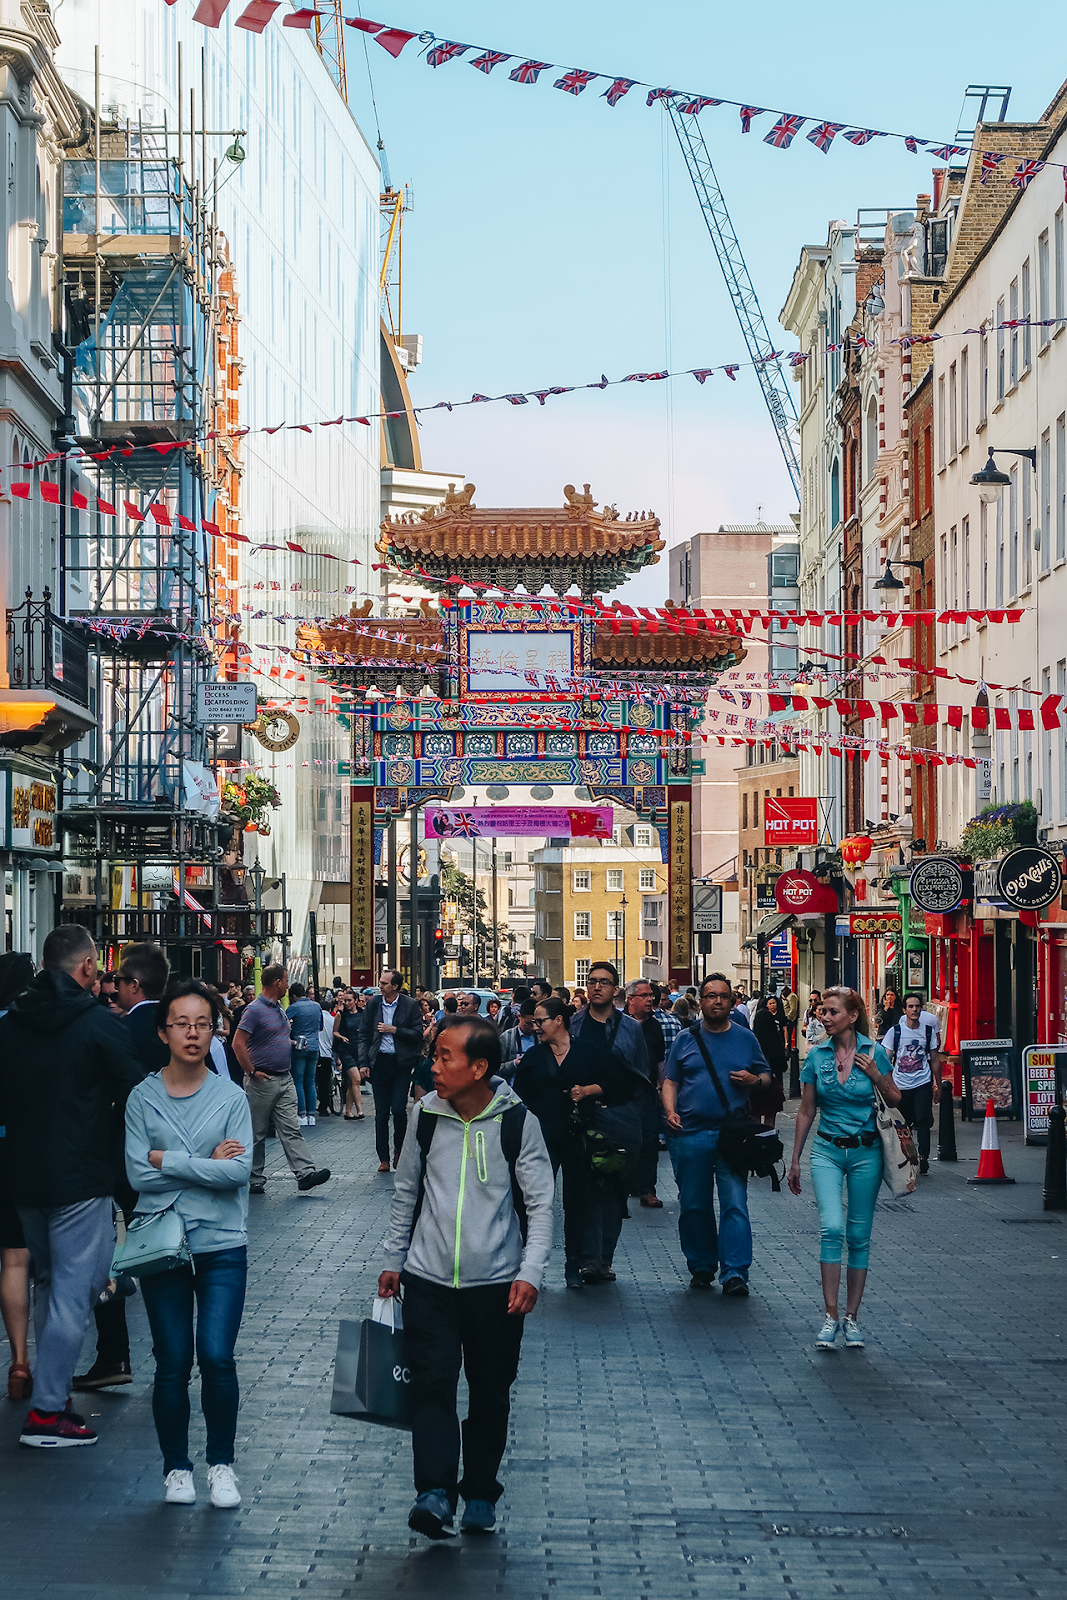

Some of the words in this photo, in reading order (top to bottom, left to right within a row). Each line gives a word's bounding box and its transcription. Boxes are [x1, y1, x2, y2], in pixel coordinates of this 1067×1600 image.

[770, 391, 786, 425] WOLFF
[472, 648, 569, 671] 英倫呈祥
[765, 819, 790, 831] HOT
[792, 819, 816, 831] POT
[1005, 858, 1053, 897] O'Neill's
[782, 888, 797, 896] HOT
[798, 888, 813, 896] POT
[1015, 895, 1027, 904] EAT
[1031, 893, 1050, 905] DRINK
[1049, 870, 1057, 891] ENJOY
[1032, 1054, 1051, 1066] SUN
[1029, 1068, 1049, 1079] BEER
[1037, 1080, 1056, 1091] SPIR
[1037, 1093, 1056, 1103] LOTT
[1030, 1105, 1049, 1116] SOFT
[1030, 1117, 1050, 1129] CONFE
[392, 1364, 411, 1384] ec
